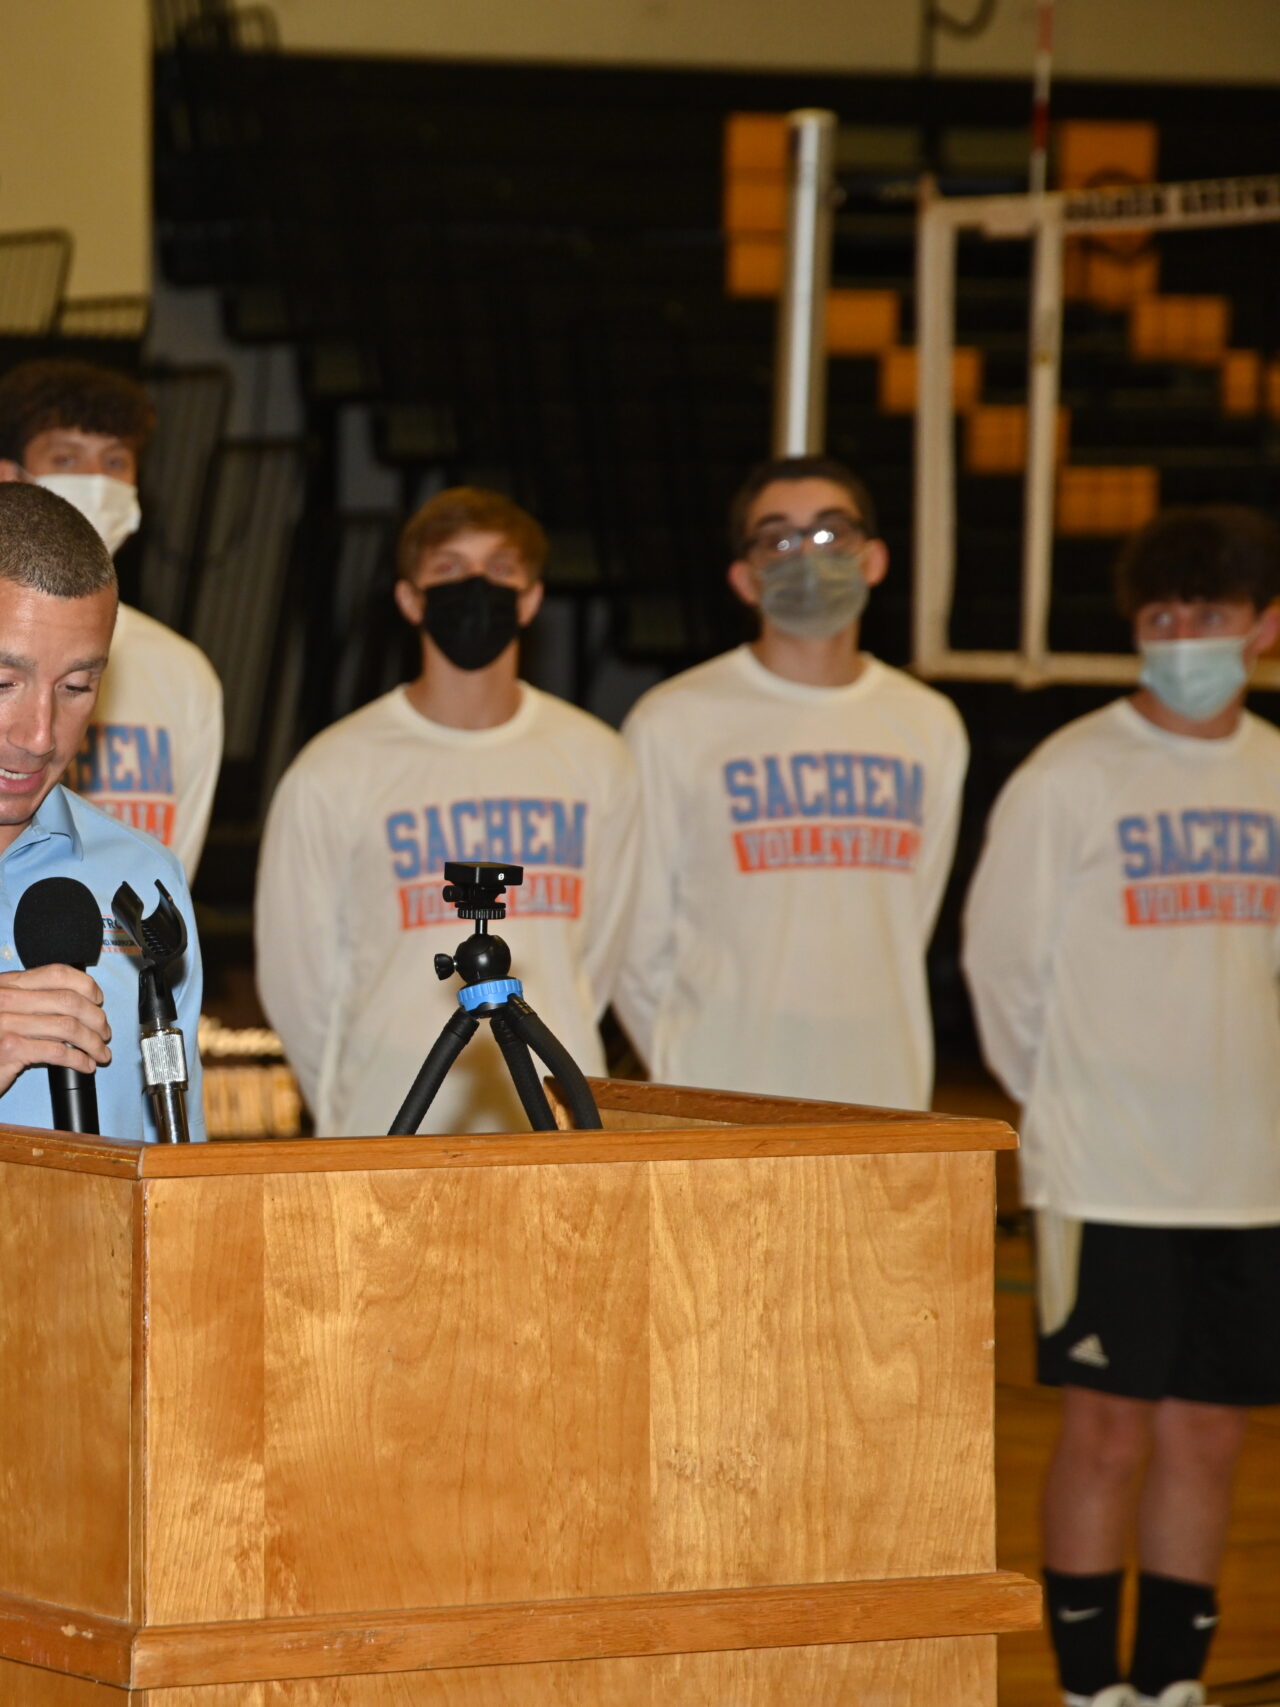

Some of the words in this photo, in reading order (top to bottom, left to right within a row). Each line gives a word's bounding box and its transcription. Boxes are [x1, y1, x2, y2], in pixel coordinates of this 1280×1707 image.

[64, 724, 173, 794] HEM
[724, 752, 925, 826] SACHEM
[386, 799, 587, 879] SACHEM
[1117, 811, 1280, 879] SACHE
